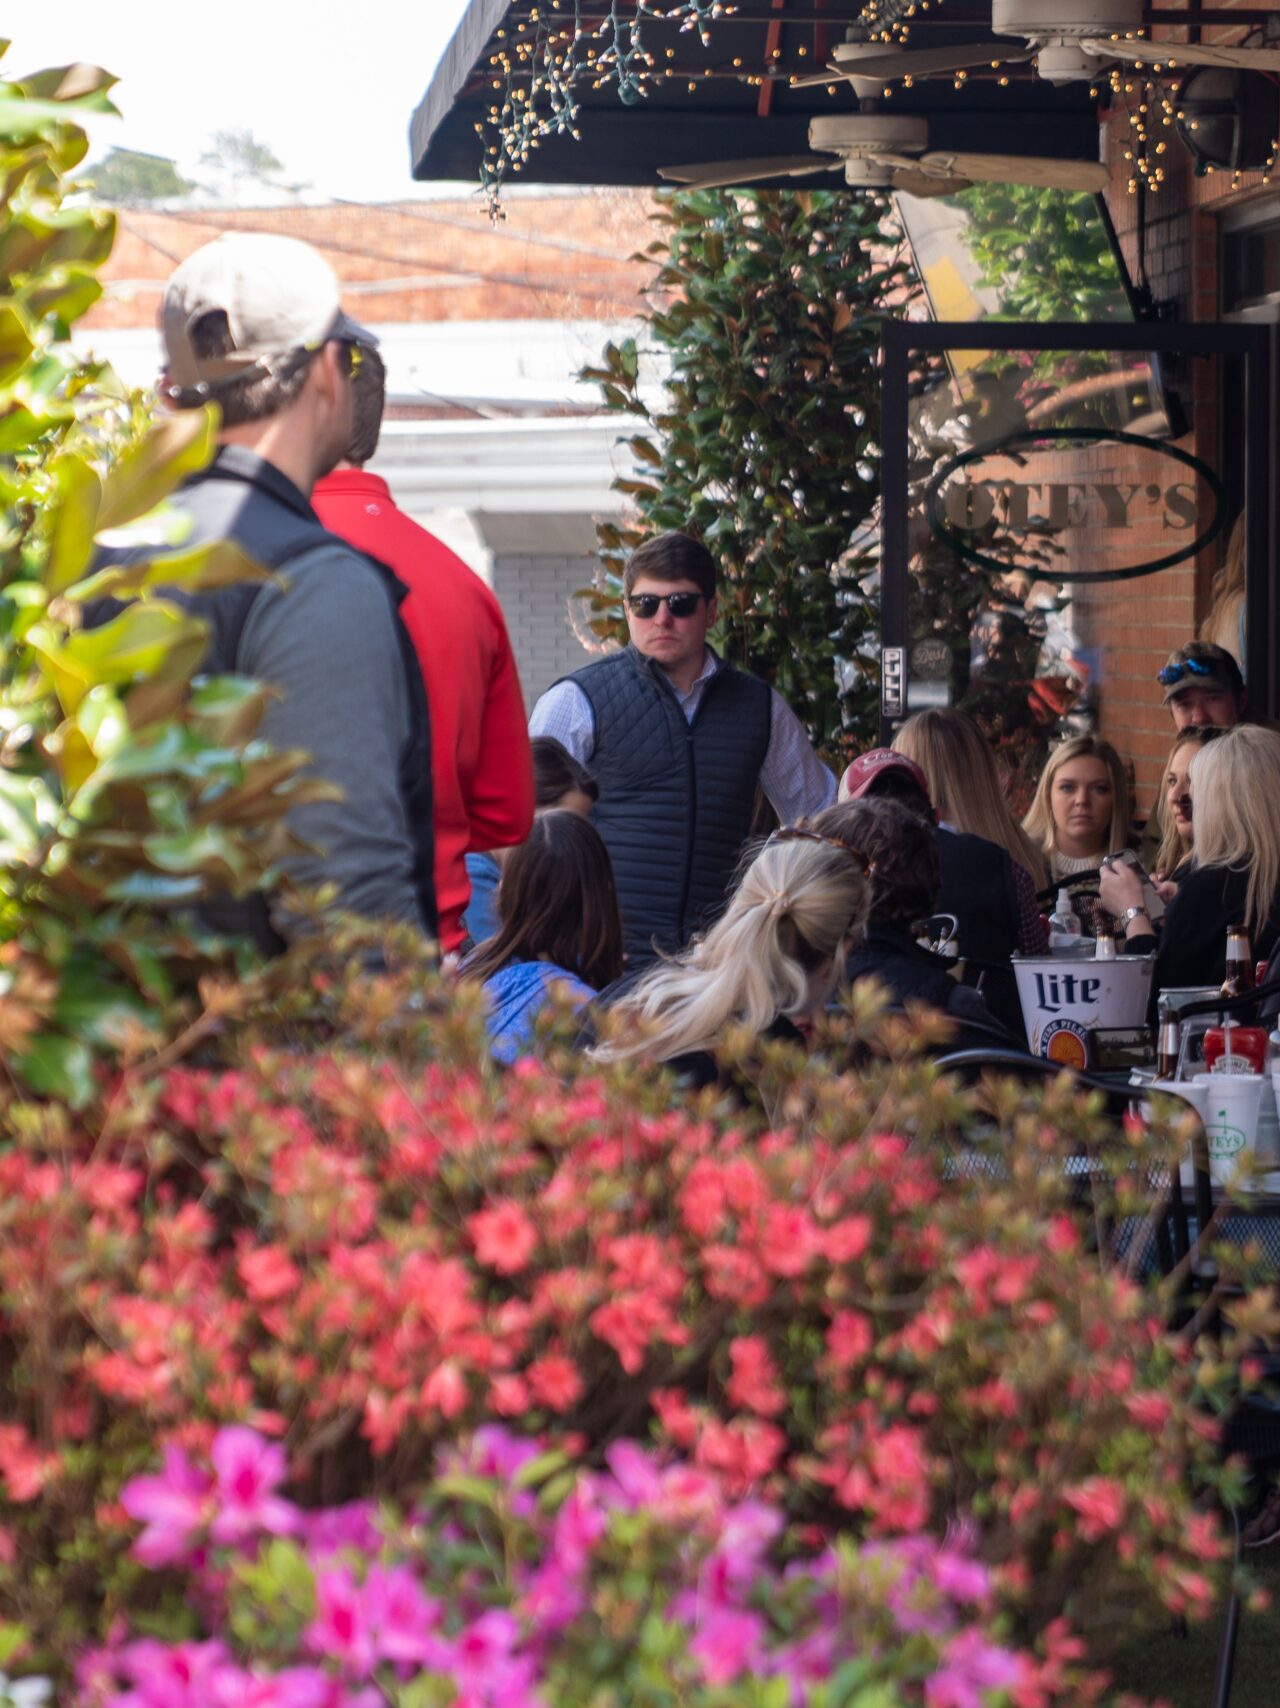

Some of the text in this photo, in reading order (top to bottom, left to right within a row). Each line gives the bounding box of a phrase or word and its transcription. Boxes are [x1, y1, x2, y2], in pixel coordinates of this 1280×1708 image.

[944, 482, 1200, 530] OTEY'S
[884, 650, 900, 702] PULL
[1033, 972, 1101, 1013] Lite
[1043, 1021, 1059, 1042] FINE
